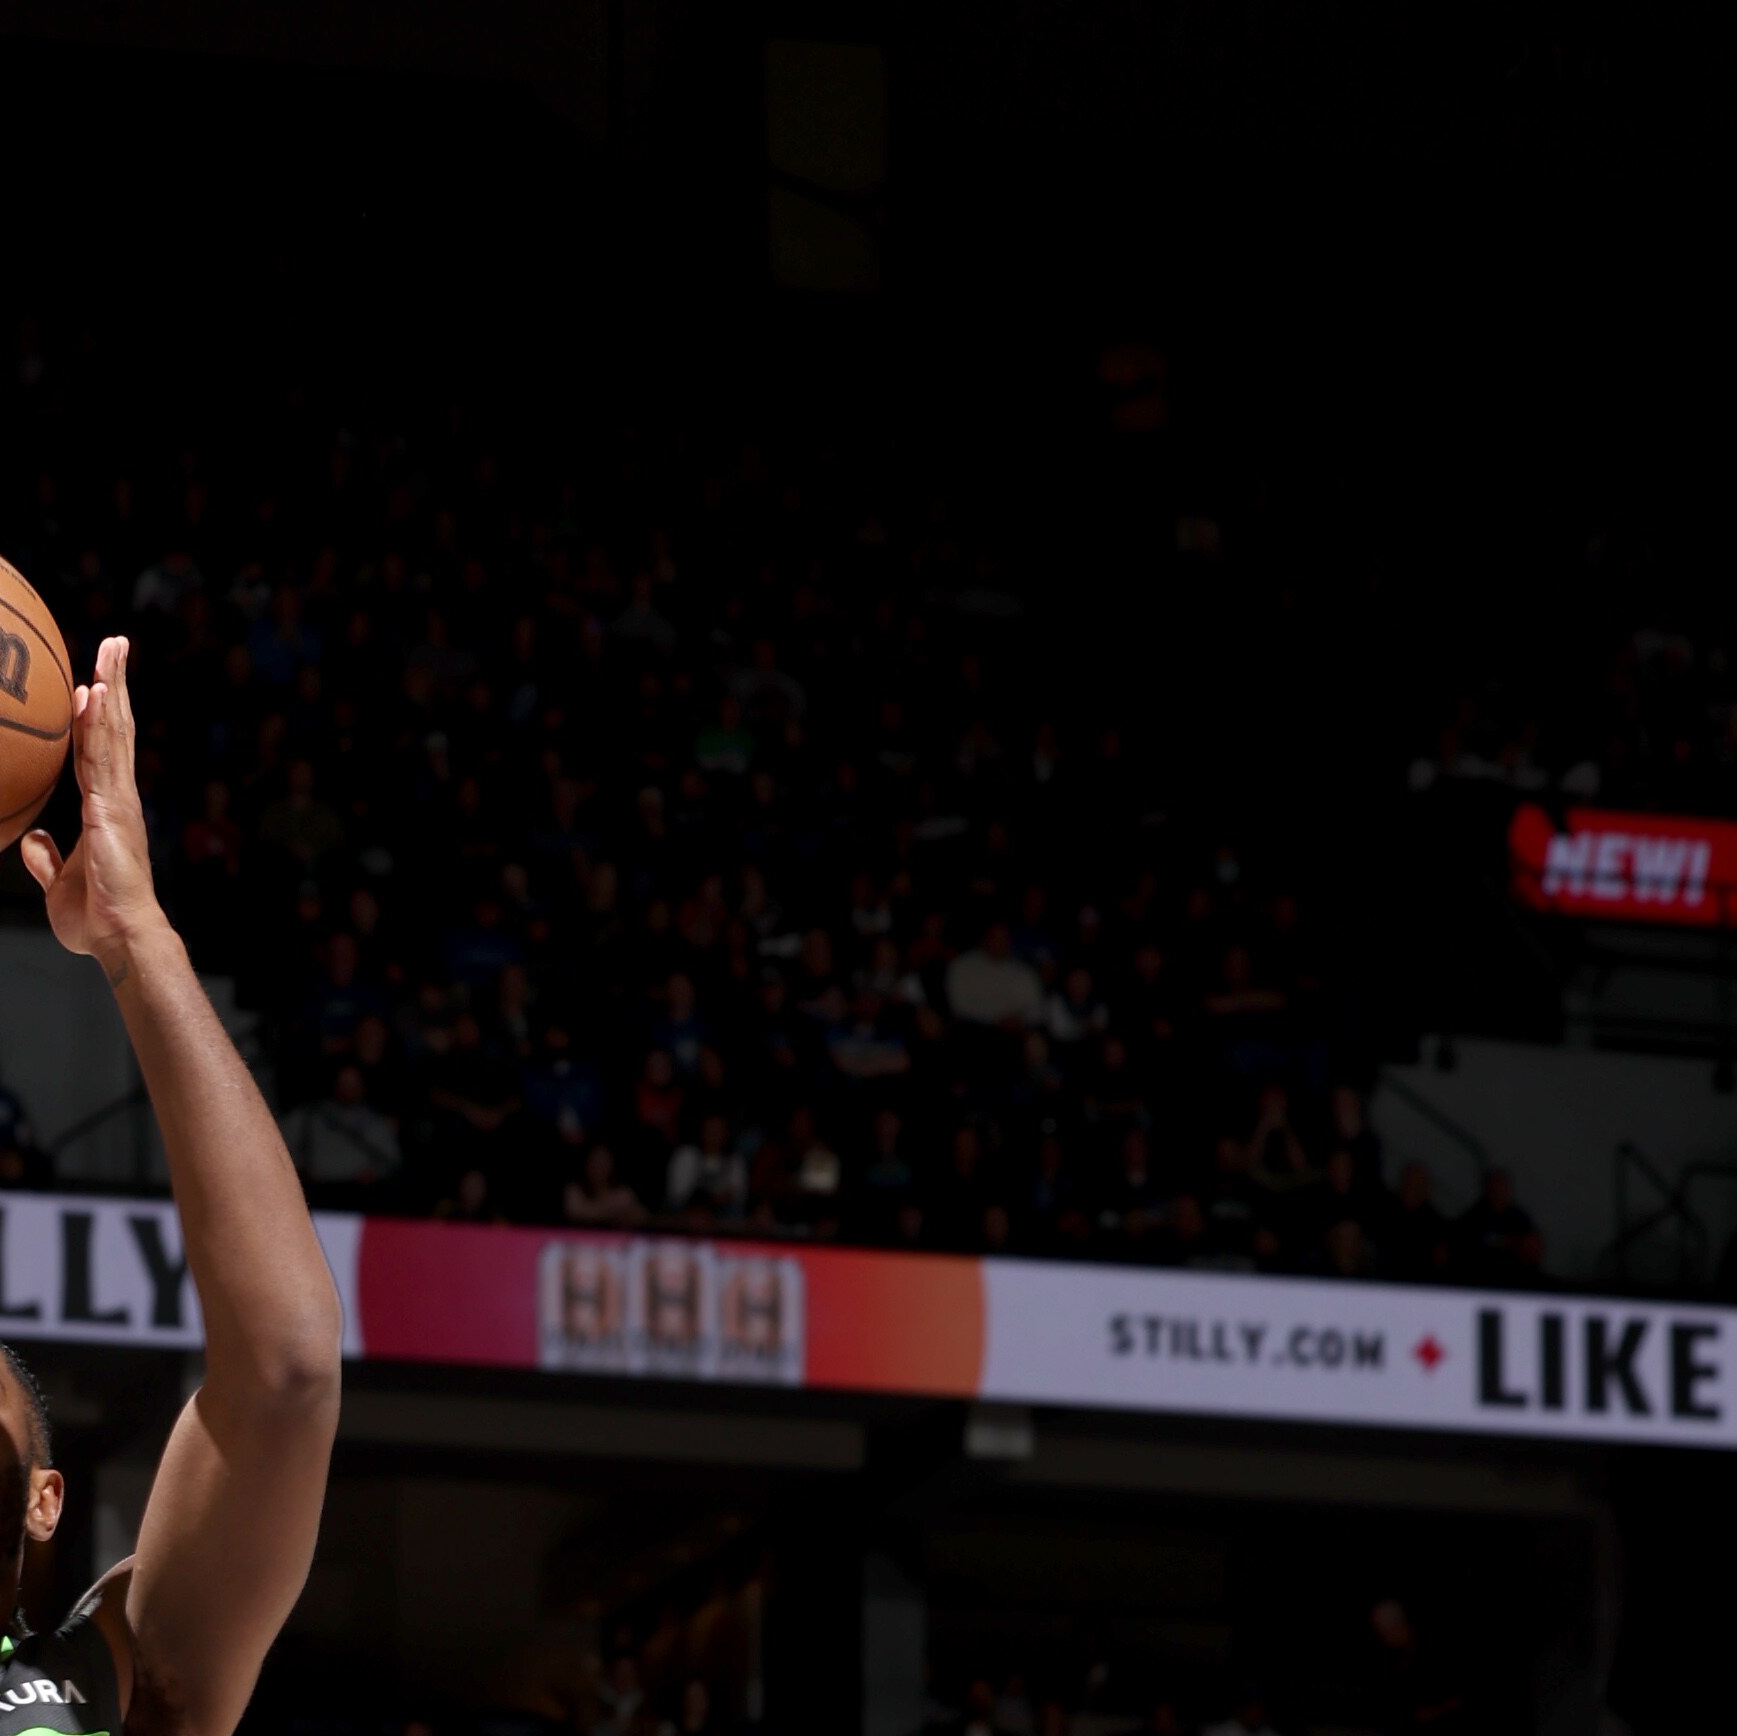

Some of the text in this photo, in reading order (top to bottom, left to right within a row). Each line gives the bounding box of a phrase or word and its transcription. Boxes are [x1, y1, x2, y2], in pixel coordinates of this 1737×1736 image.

[1540, 829, 1712, 908] NEW!
[1105, 1313, 1389, 1372] STILLY.COM
[1475, 1306, 1723, 1422] LIKE
